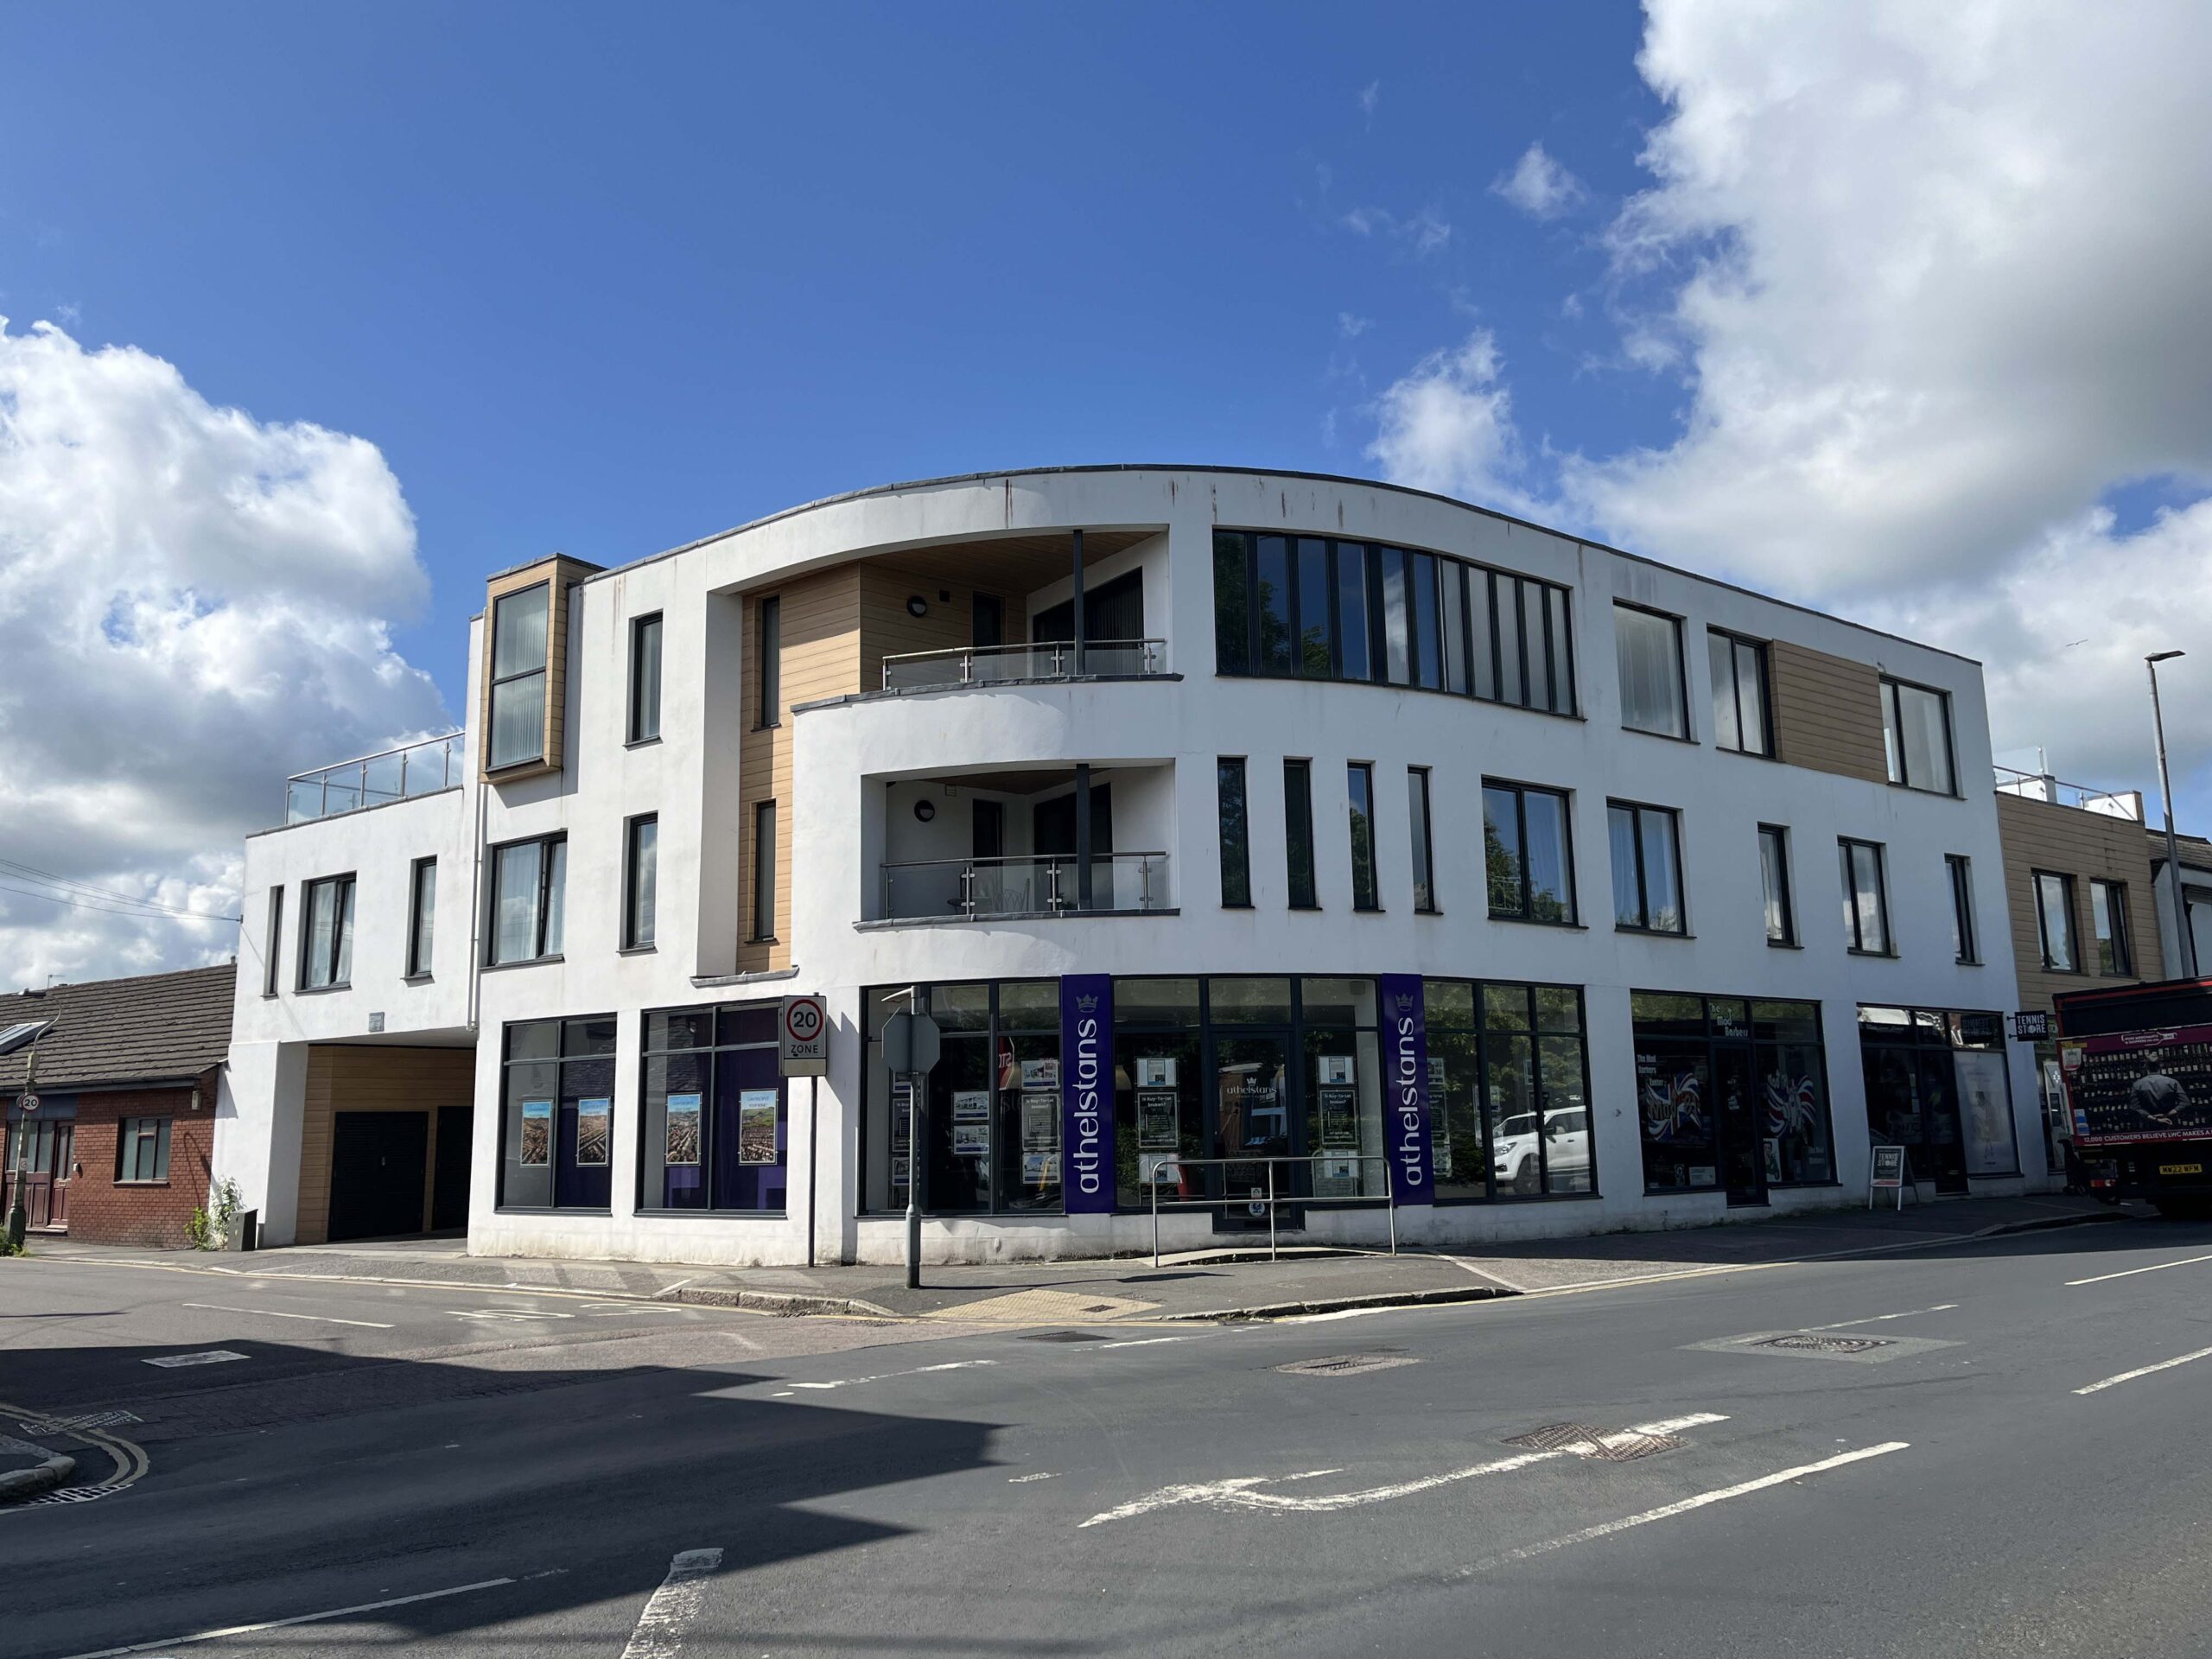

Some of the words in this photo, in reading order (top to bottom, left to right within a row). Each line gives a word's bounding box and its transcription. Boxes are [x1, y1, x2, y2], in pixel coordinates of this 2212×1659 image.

[793, 1012, 817, 1028] 20
[2017, 1014, 2045, 1025] TENNIS
[2018, 1023, 2047, 1035] STORE
[791, 1044, 819, 1054] ZONE
[1226, 1084, 1278, 1095] athelstans
[24, 1098, 38, 1107] 20
[1072, 1019, 1099, 1194] athelstans
[1395, 1017, 1423, 1186] athelstans
[1878, 1153, 1898, 1161] TENNIS
